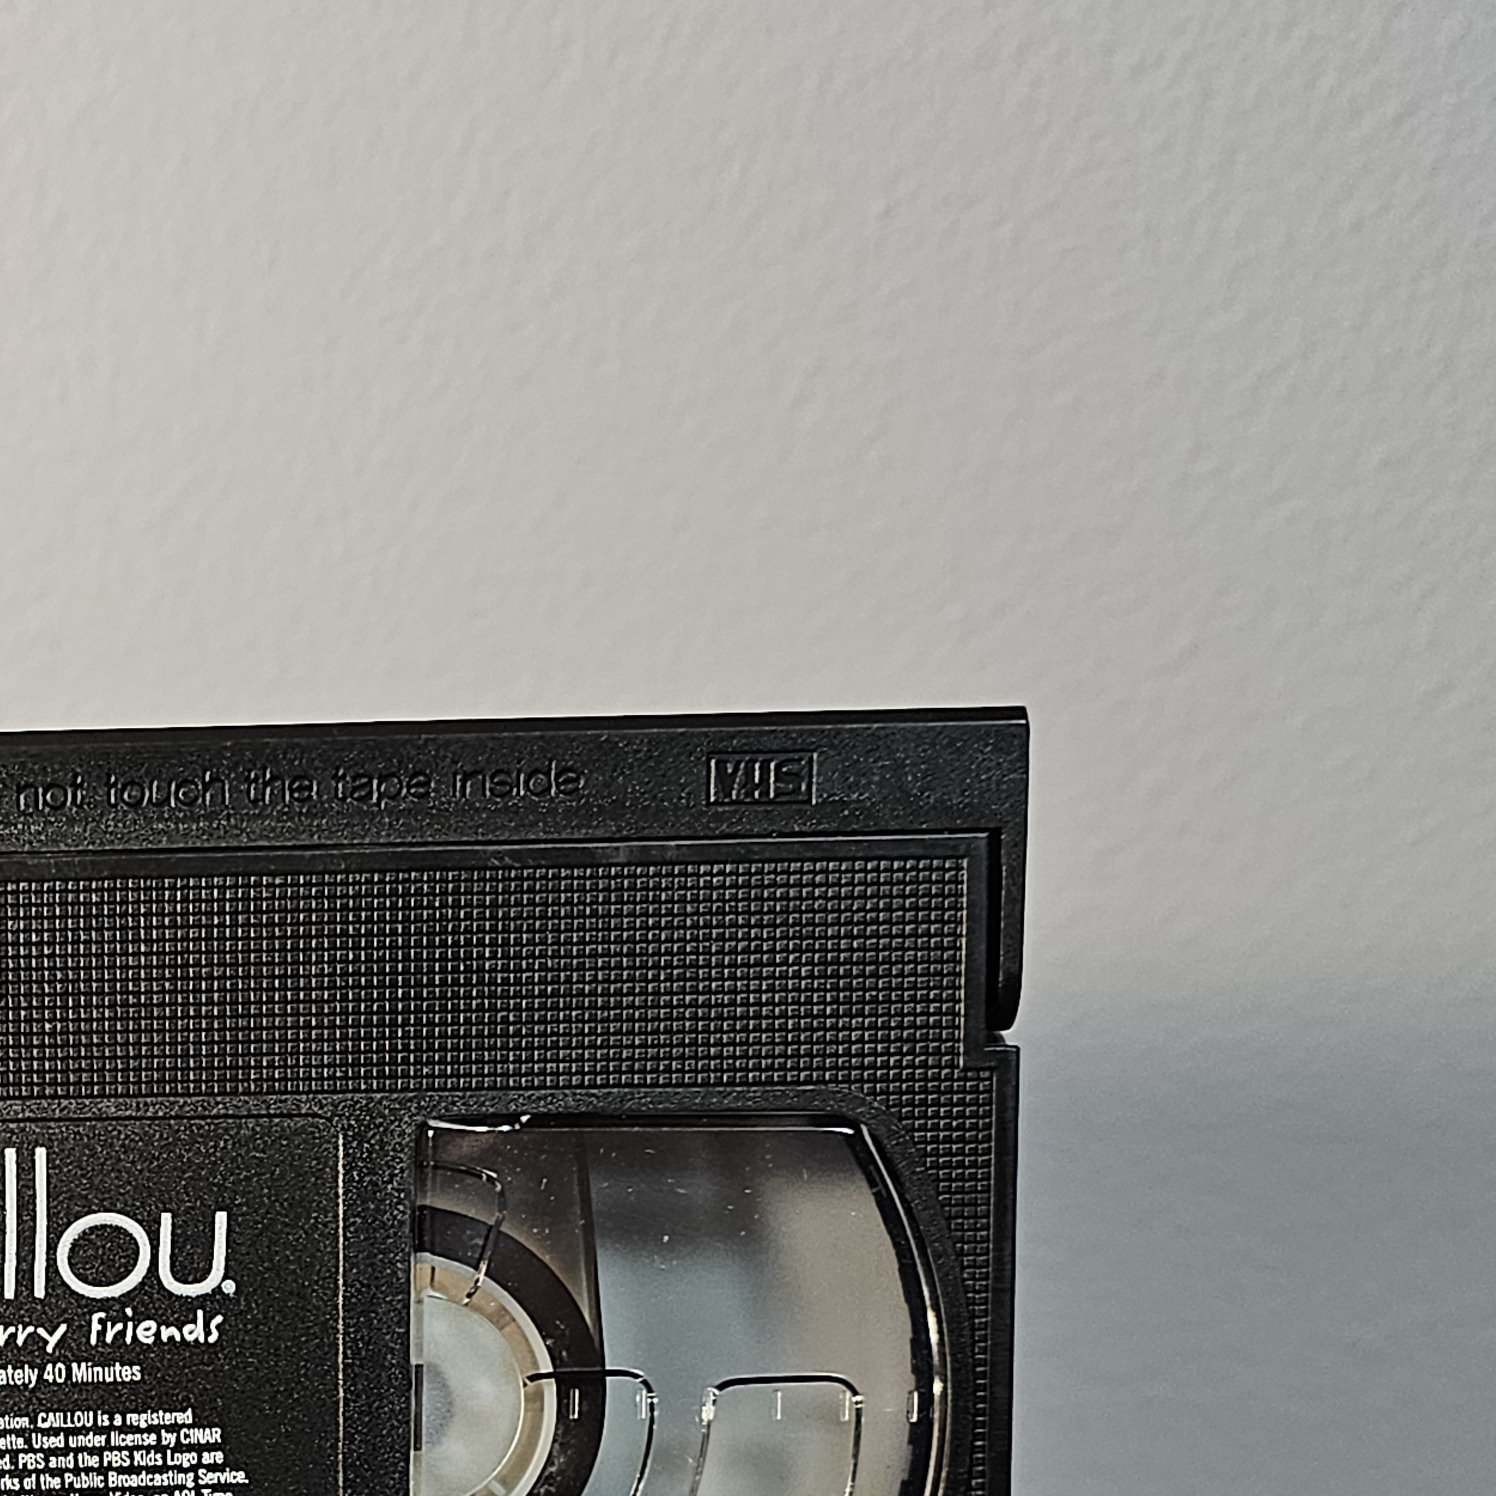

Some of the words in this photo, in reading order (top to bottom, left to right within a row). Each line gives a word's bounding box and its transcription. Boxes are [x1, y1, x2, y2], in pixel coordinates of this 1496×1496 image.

[16, 774, 83, 811] not
[105, 770, 230, 809] touch
[245, 767, 318, 805] the
[332, 767, 434, 811] tape
[453, 760, 585, 799] inside
[90, 1307, 224, 1347] Friends
[43, 1362, 66, 1383] 40
[71, 1361, 141, 1384] Minutes
[37, 1411, 93, 1428] CAILLOU
[97, 1410, 109, 1427] is
[113, 1413, 122, 1427] a
[126, 1408, 193, 1428] registered
[32, 1432, 64, 1449] Used
[68, 1430, 106, 1448] under
[110, 1430, 157, 1447] license
[161, 1429, 176, 1448] by
[180, 1427, 222, 1445] CINAR
[18, 1453, 45, 1470] PBS
[49, 1452, 74, 1469] and
[78, 1451, 100, 1468] the
[103, 1450, 130, 1467] PBS
[133, 1449, 163, 1466] Kids
[167, 1448, 198, 1468] Logo
[201, 1450, 224, 1465] are
[23, 1473, 37, 1490] of
[40, 1472, 61, 1489] the
[64, 1471, 105, 1489] Public
[108, 1469, 195, 1488] Broadcasting
[198, 1467, 249, 1485] Service.
